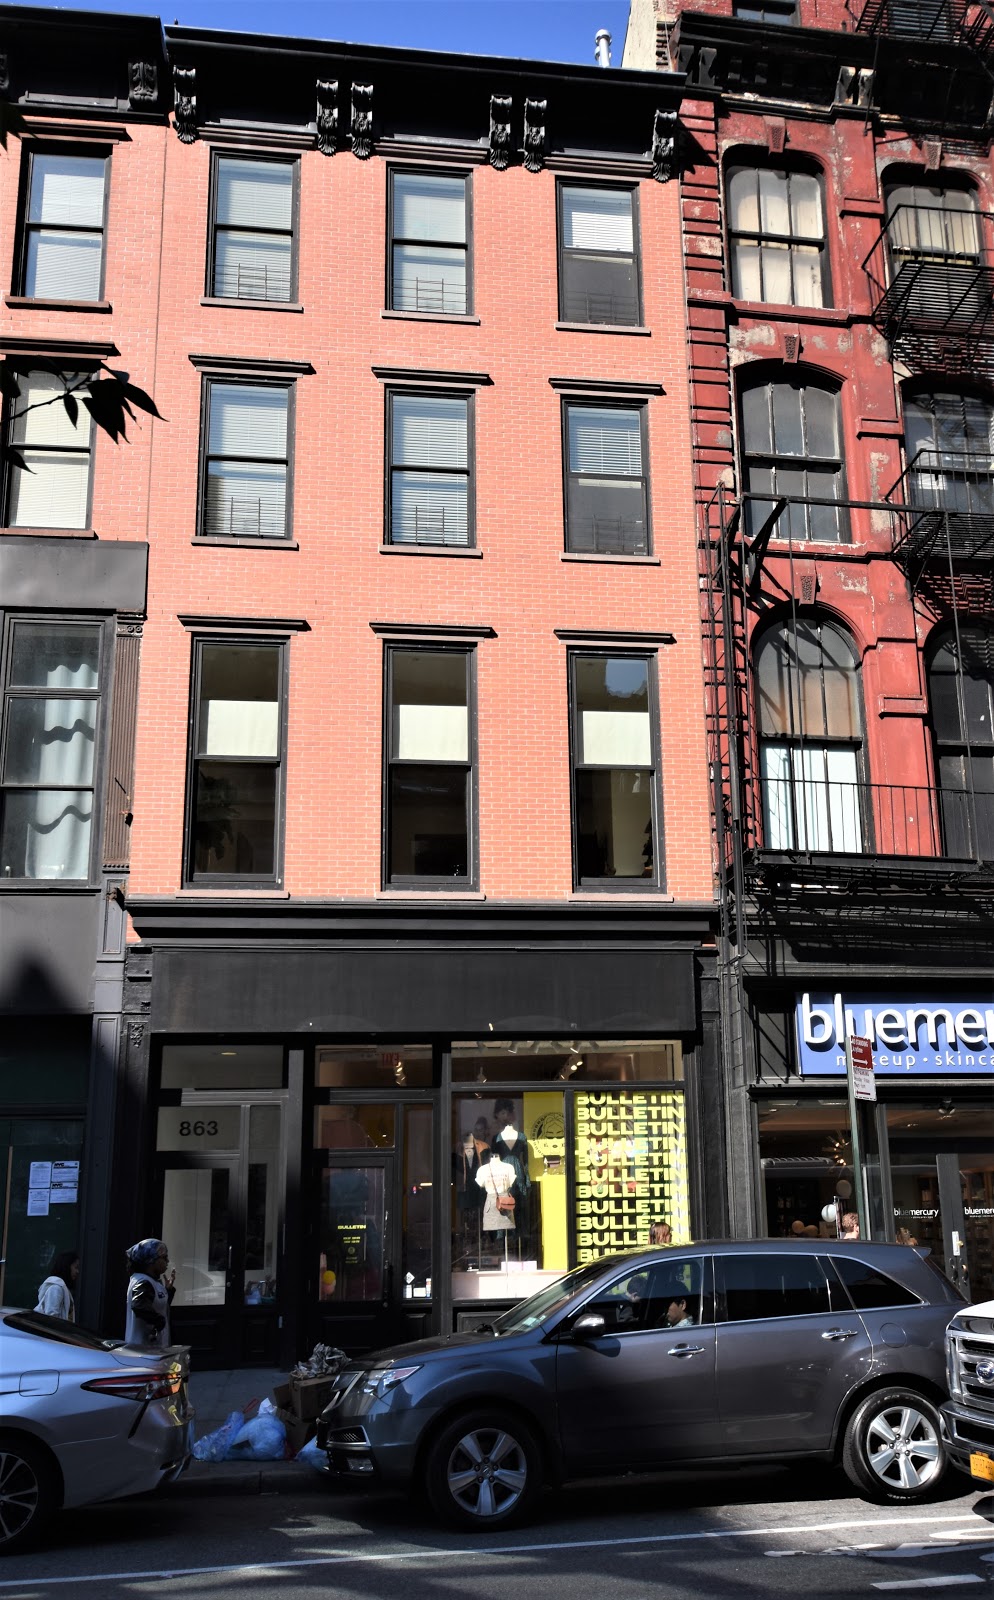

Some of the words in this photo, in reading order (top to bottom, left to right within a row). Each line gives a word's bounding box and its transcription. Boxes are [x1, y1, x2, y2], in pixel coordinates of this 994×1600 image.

[836, 1054, 916, 1069] mkeup
[577, 1091, 684, 1105] BULLETIN
[578, 1106, 685, 1120] BULLETIN
[180, 1121, 218, 1136] 863
[578, 1121, 685, 1135] BULLETIN
[578, 1136, 686, 1151] BULLETIN
[579, 1152, 686, 1166] BULLETIN
[579, 1168, 687, 1182] BULLETIN
[579, 1183, 688, 1198] BULLETIN
[579, 1199, 688, 1214] BULLETIN
[893, 1207, 939, 1217] bluemercury
[964, 1206, 994, 1215] bluemer
